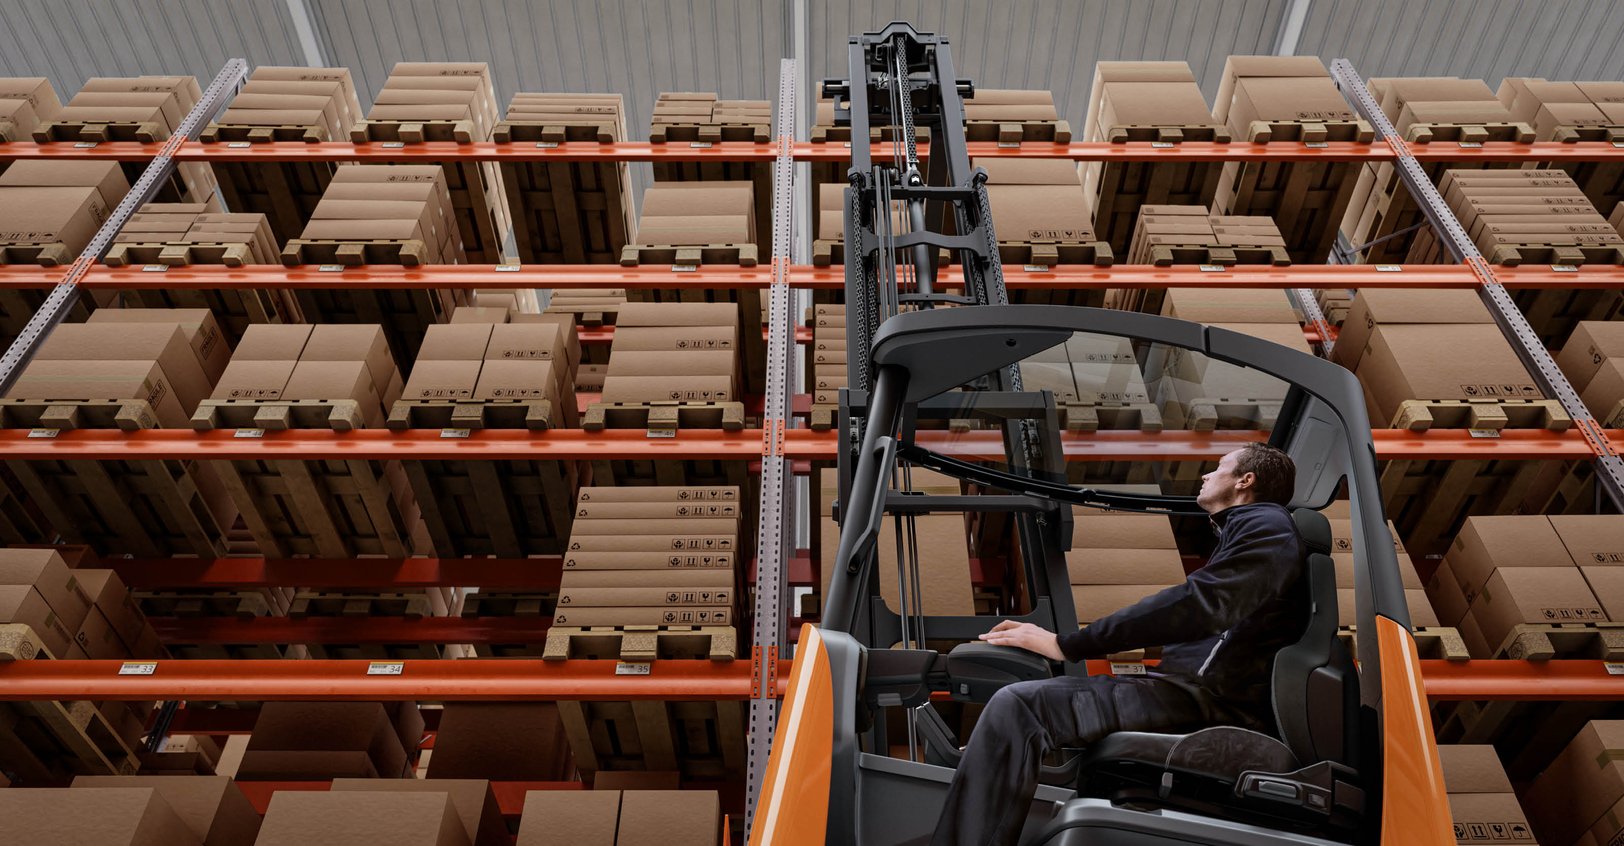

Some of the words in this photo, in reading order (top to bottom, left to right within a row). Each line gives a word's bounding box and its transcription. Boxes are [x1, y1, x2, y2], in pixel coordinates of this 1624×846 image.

[140, 665, 154, 673] 33
[389, 665, 401, 673] 34
[637, 665, 649, 673] 35
[1132, 665, 1144, 673] 37
